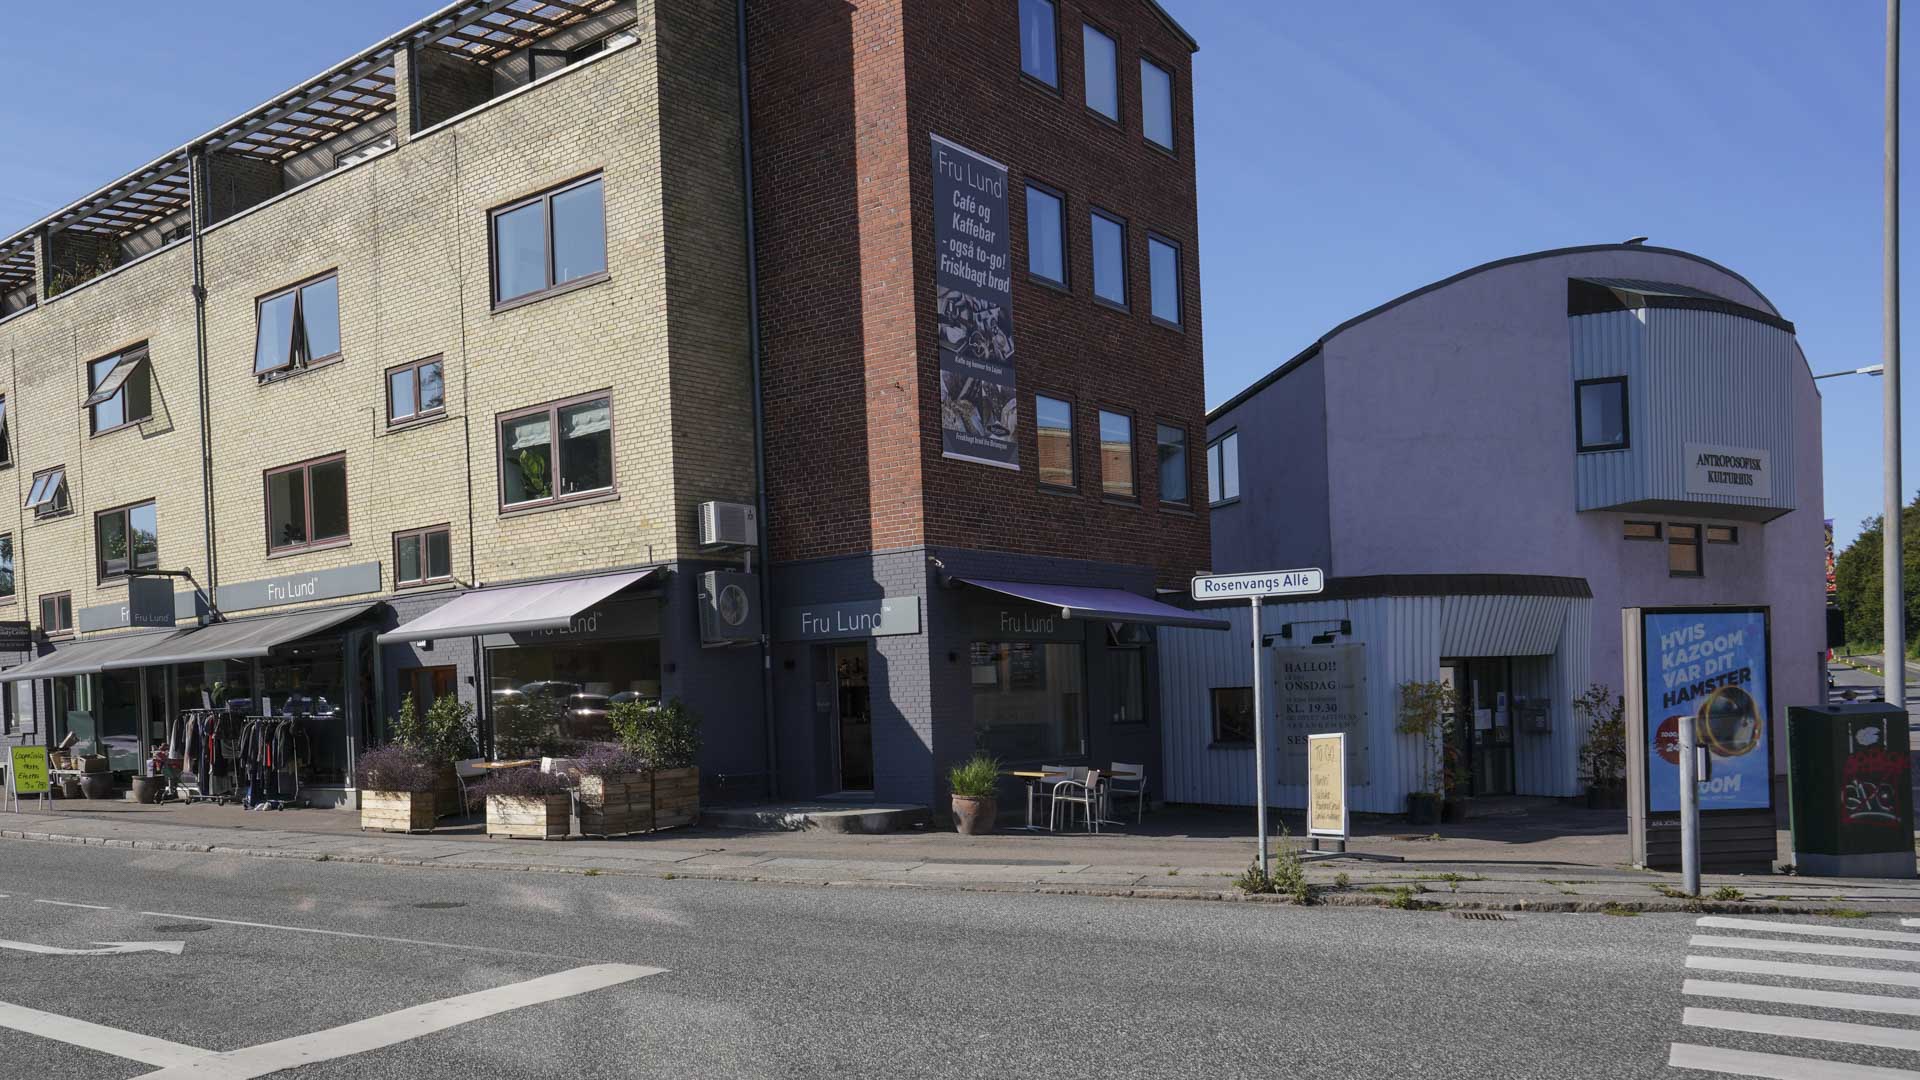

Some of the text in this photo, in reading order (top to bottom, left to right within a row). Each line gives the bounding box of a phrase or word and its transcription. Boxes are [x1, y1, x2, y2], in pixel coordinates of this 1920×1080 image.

[938, 151, 1002, 199] Fru Lund
[952, 190, 991, 223] Café og
[952, 212, 996, 244] Kaffebar
[950, 239, 974, 258] også
[976, 246, 1006, 270] to-go!
[940, 254, 1010, 293] Friskbagt brød
[1696, 453, 1762, 471] ANTROPOSOFISK
[1707, 470, 1754, 487] KULTURHUS
[268, 577, 315, 601] Fru Lund
[1204, 573, 1309, 593] Rosenvangs Allé
[121, 607, 130, 622] Fr
[134, 611, 169, 623] Fru Lund
[802, 612, 830, 633] Fru
[1001, 611, 1054, 633] Fru Lund
[1661, 623, 1705, 652] HVIS
[1662, 629, 1744, 671] KAZOOM
[1285, 660, 1337, 673] HALLO!!
[1663, 652, 1735, 689] VAR DIT
[1285, 680, 1336, 691] ONSDAG
[1663, 666, 1752, 709] HAMSTER
[1286, 703, 1338, 713] KL. 19.30
